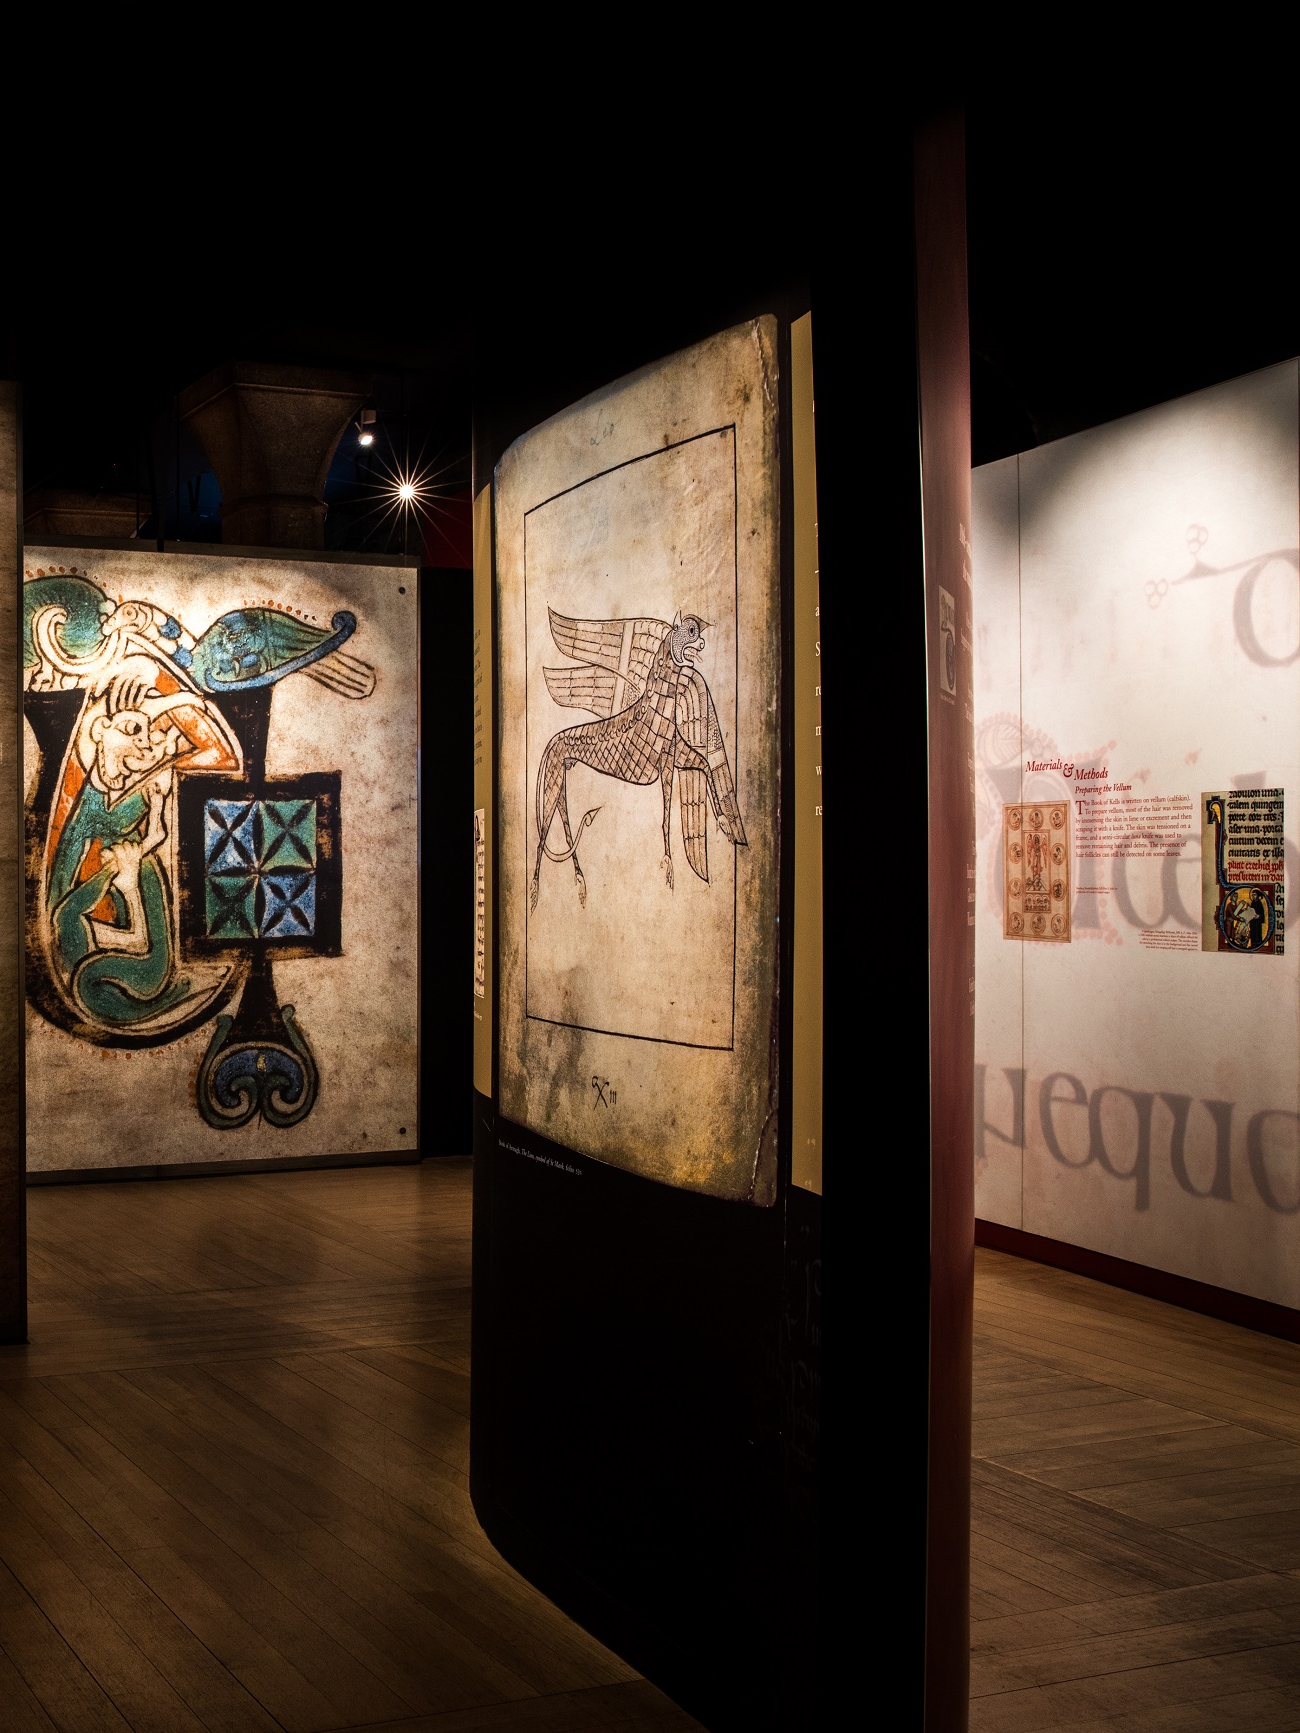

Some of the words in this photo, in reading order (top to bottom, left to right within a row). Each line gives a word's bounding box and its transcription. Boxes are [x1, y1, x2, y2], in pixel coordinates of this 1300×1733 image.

[1025, 759, 1062, 772] Materials
[1063, 763, 1074, 778] &
[1074, 767, 1109, 781] Methods
[1075, 785, 1102, 796] Preparing
[1103, 784, 1112, 793] the
[1113, 783, 1132, 792] Vellum
